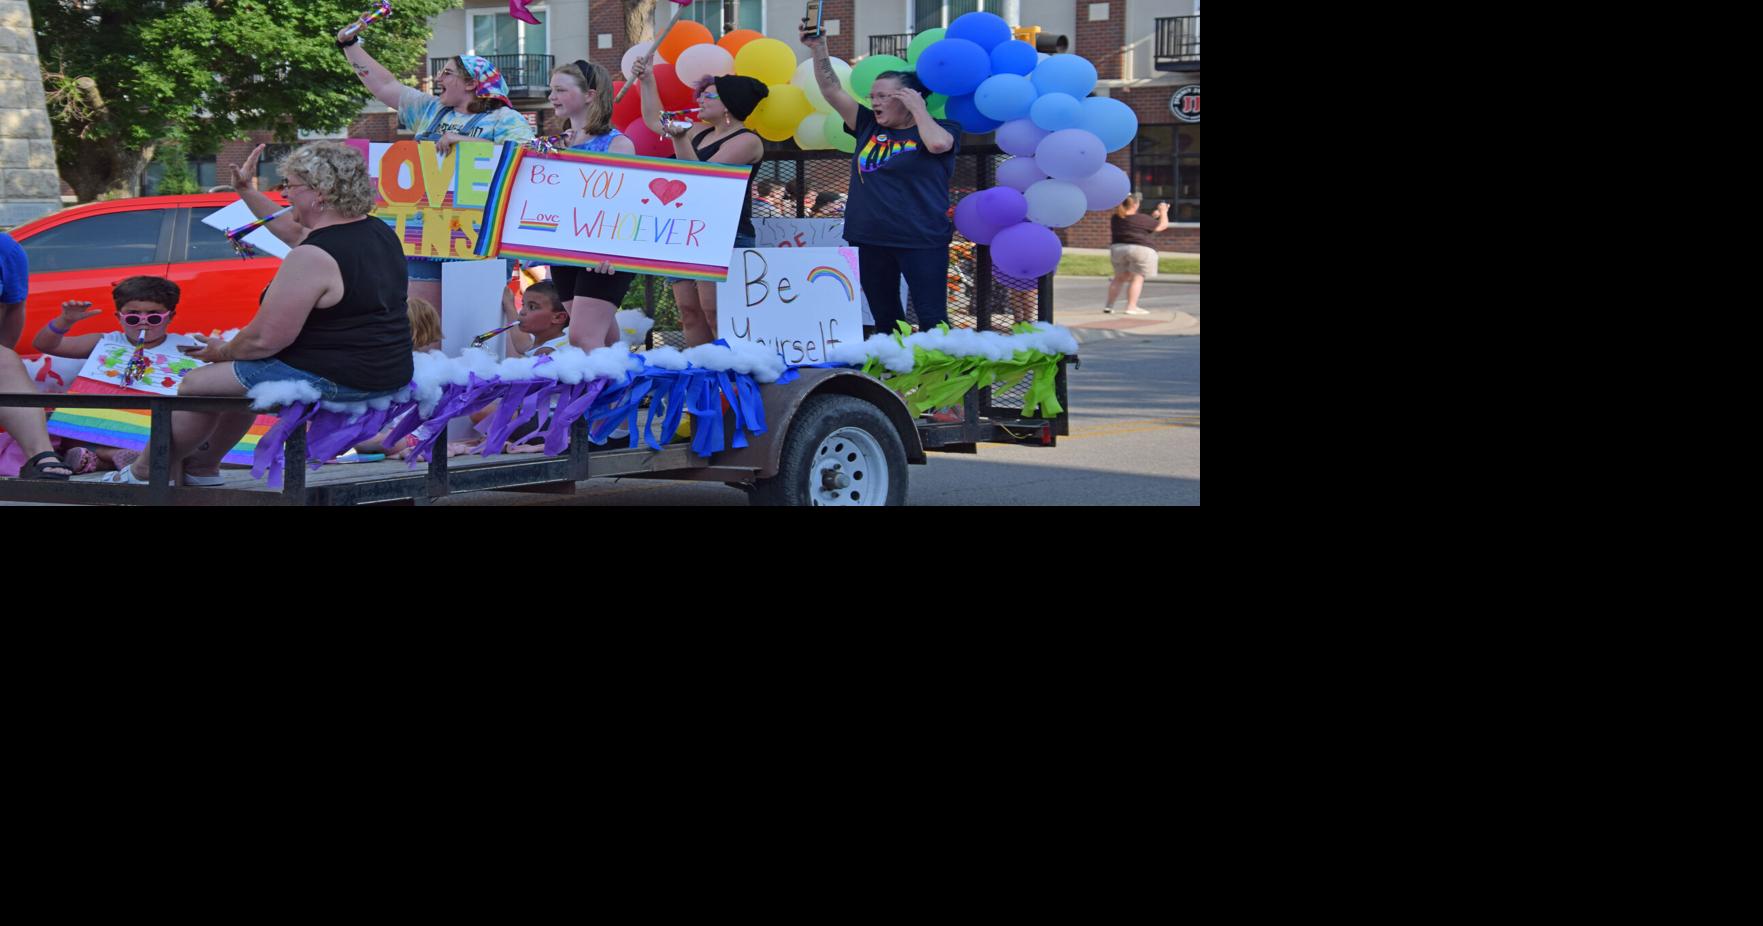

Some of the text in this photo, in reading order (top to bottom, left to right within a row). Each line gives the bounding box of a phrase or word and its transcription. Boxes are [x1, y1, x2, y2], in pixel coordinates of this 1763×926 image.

[531, 164, 625, 200] Be YOU
[367, 205, 486, 259] INS
[519, 199, 706, 247] Love WHOEVER
[743, 250, 799, 307] Be
[731, 316, 842, 363] Yrself
